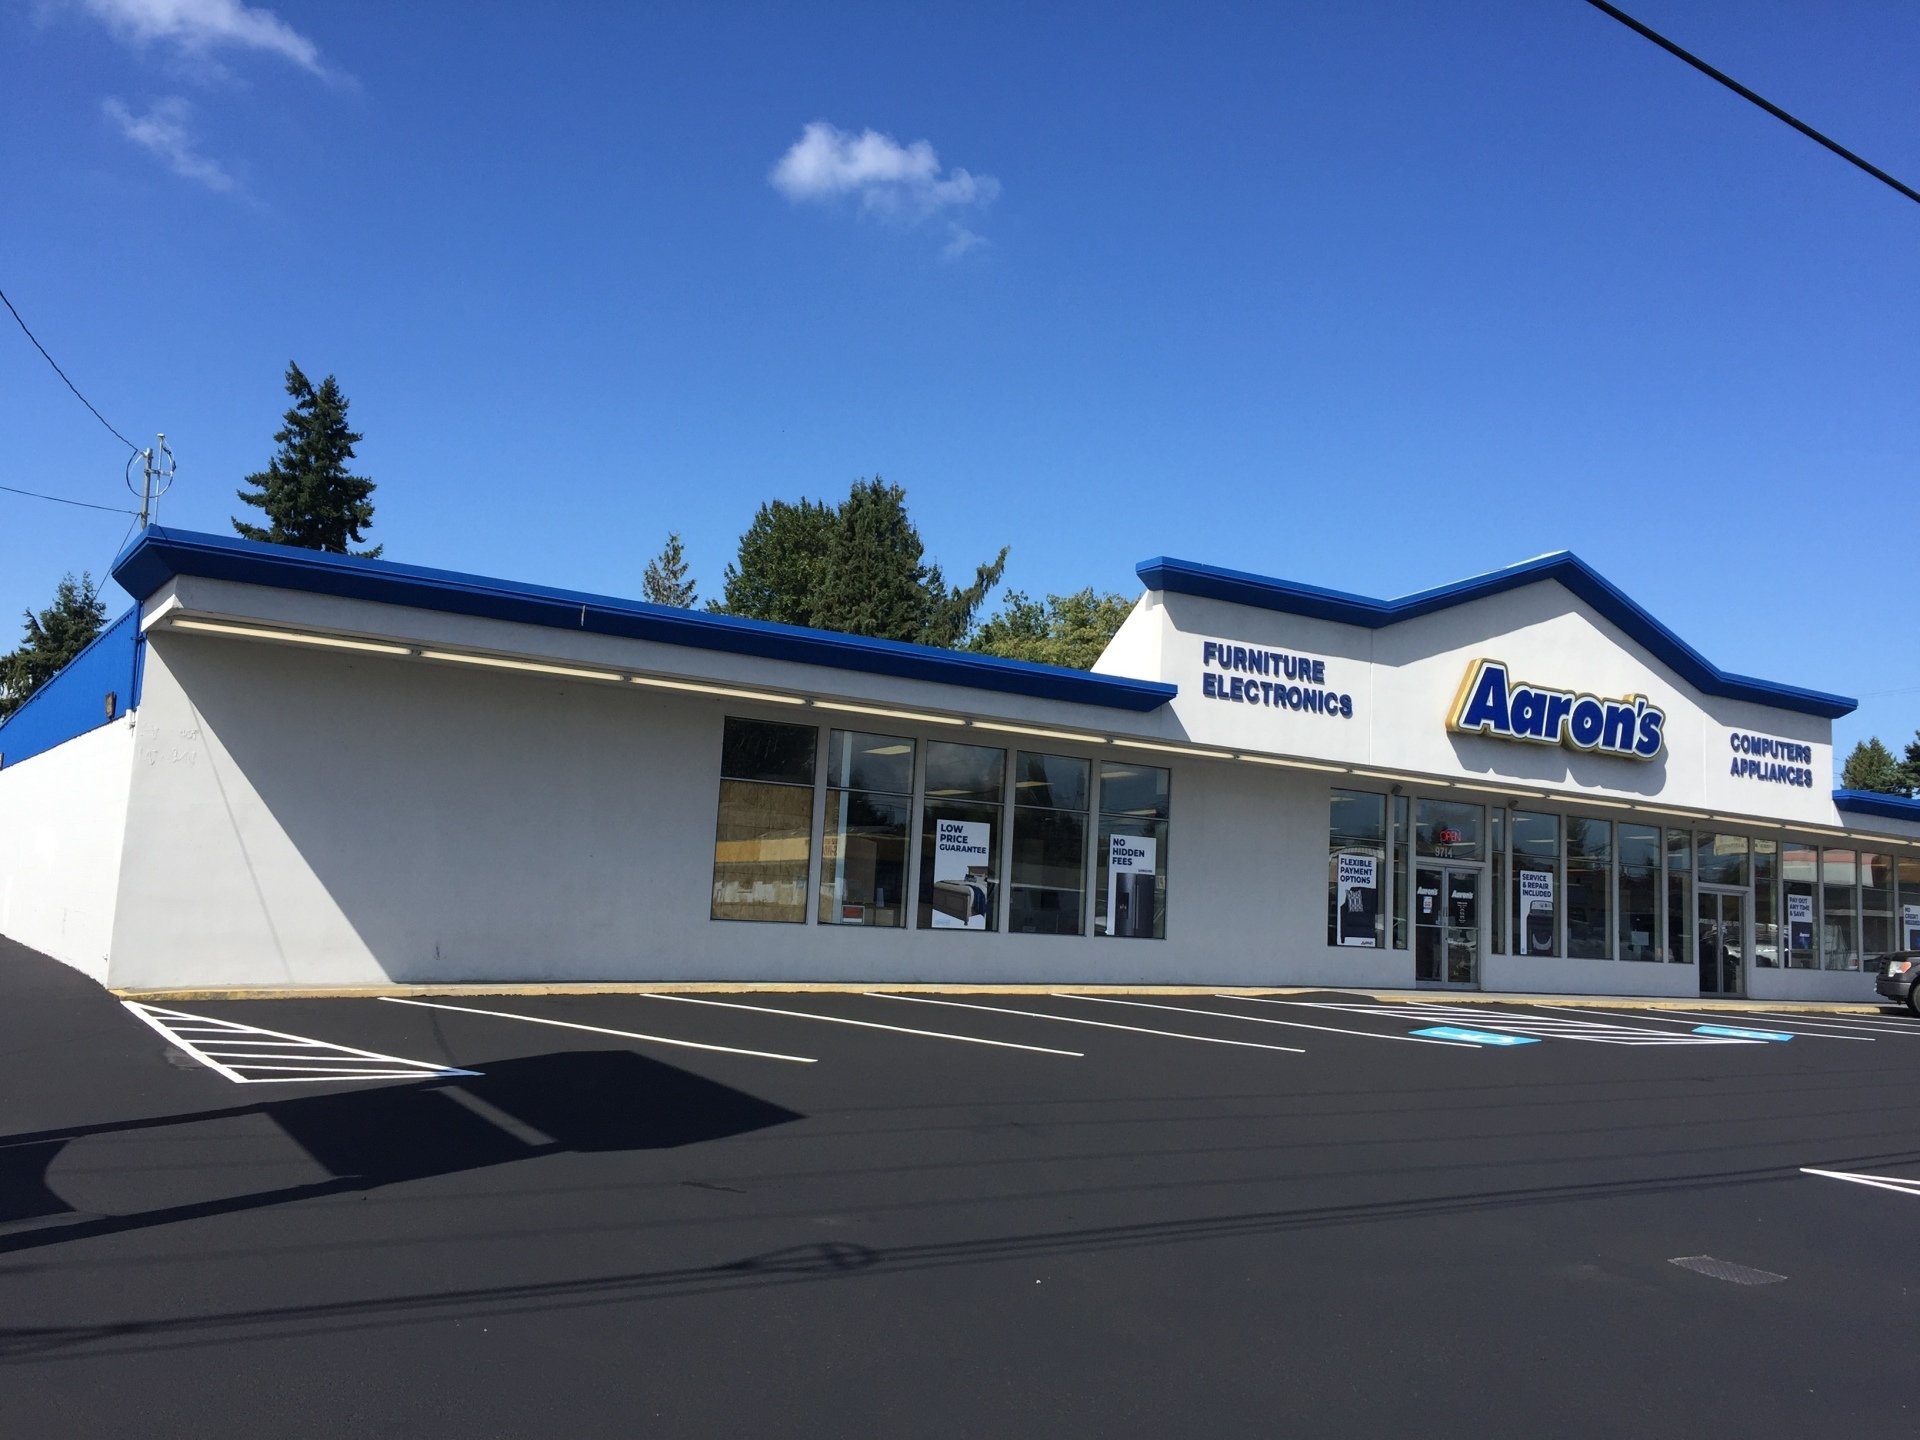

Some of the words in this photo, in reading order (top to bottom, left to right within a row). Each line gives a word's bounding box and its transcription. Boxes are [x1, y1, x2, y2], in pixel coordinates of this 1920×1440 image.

[1203, 641, 1325, 685] FURNITURE
[1203, 672, 1353, 719] ELECTRONICS
[1459, 663, 1664, 757] Aaron's
[1730, 733, 1812, 765] COMPUTERS
[1730, 757, 1813, 789] APPLIANCES
[940, 824, 963, 834] LOW
[940, 834, 969, 844] PRICE
[1440, 830, 1462, 842] OPEN
[1113, 838, 1126, 847] NO
[939, 844, 987, 854] GUARANTEE
[1112, 847, 1145, 857] HIDDEN
[1434, 847, 1453, 858] 9714
[1112, 857, 1133, 866] FEES
[1340, 858, 1372, 868] FLEXIBLE
[1340, 867, 1373, 876] PAYMENT
[1340, 875, 1371, 885] OPTIONS
[1522, 873, 1547, 882] SERVICE
[1522, 889, 1551, 897] INCLUDED
